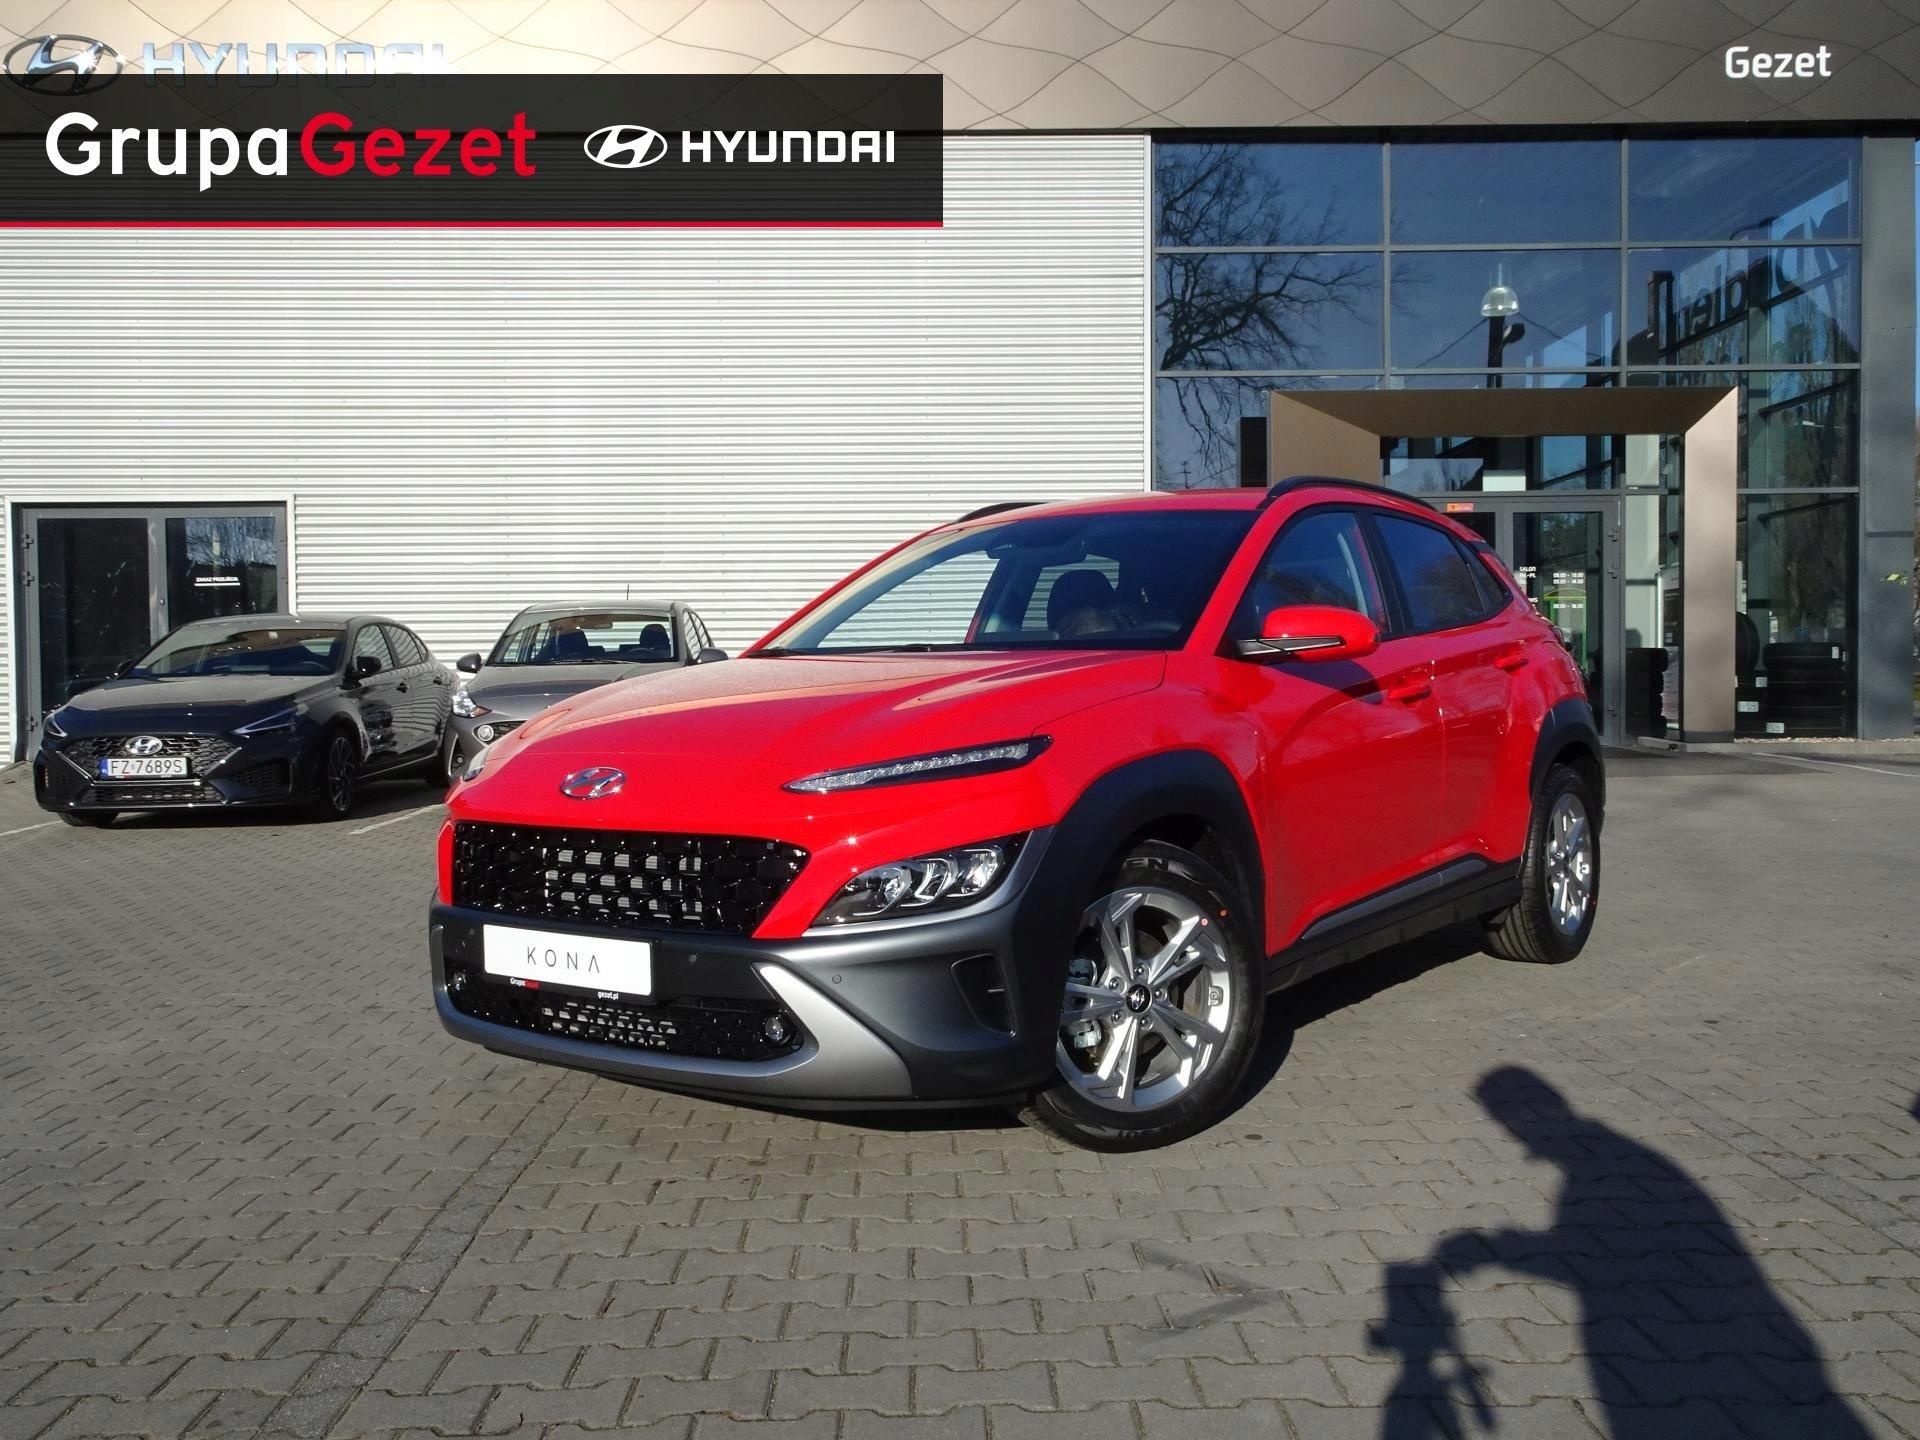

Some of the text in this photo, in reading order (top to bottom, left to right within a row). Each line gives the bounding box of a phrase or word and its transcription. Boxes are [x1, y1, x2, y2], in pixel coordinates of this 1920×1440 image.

[143, 42, 446, 87] HYUNDAI
[1724, 45, 1832, 79] Gezet
[111, 759, 182, 774] FZ 7689S
